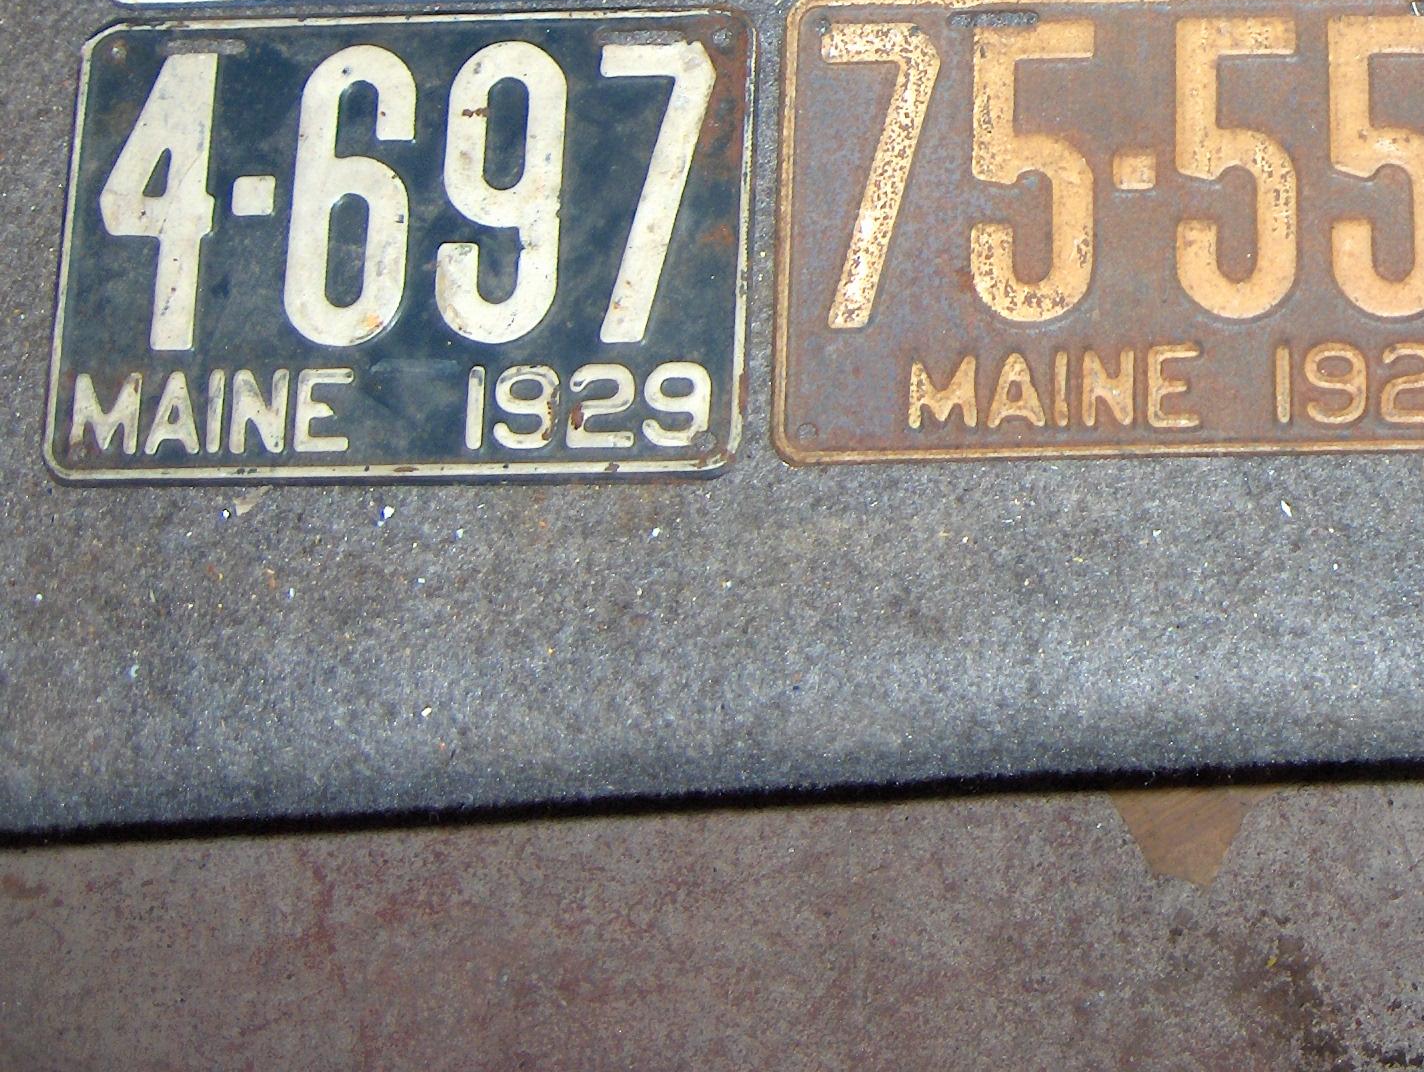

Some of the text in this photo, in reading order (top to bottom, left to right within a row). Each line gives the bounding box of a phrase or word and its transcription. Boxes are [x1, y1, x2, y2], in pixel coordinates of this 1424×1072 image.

[99, 39, 717, 352] 4-697
[69, 361, 714, 456] MAINE 1929
[907, 341, 1201, 430] MAINE
